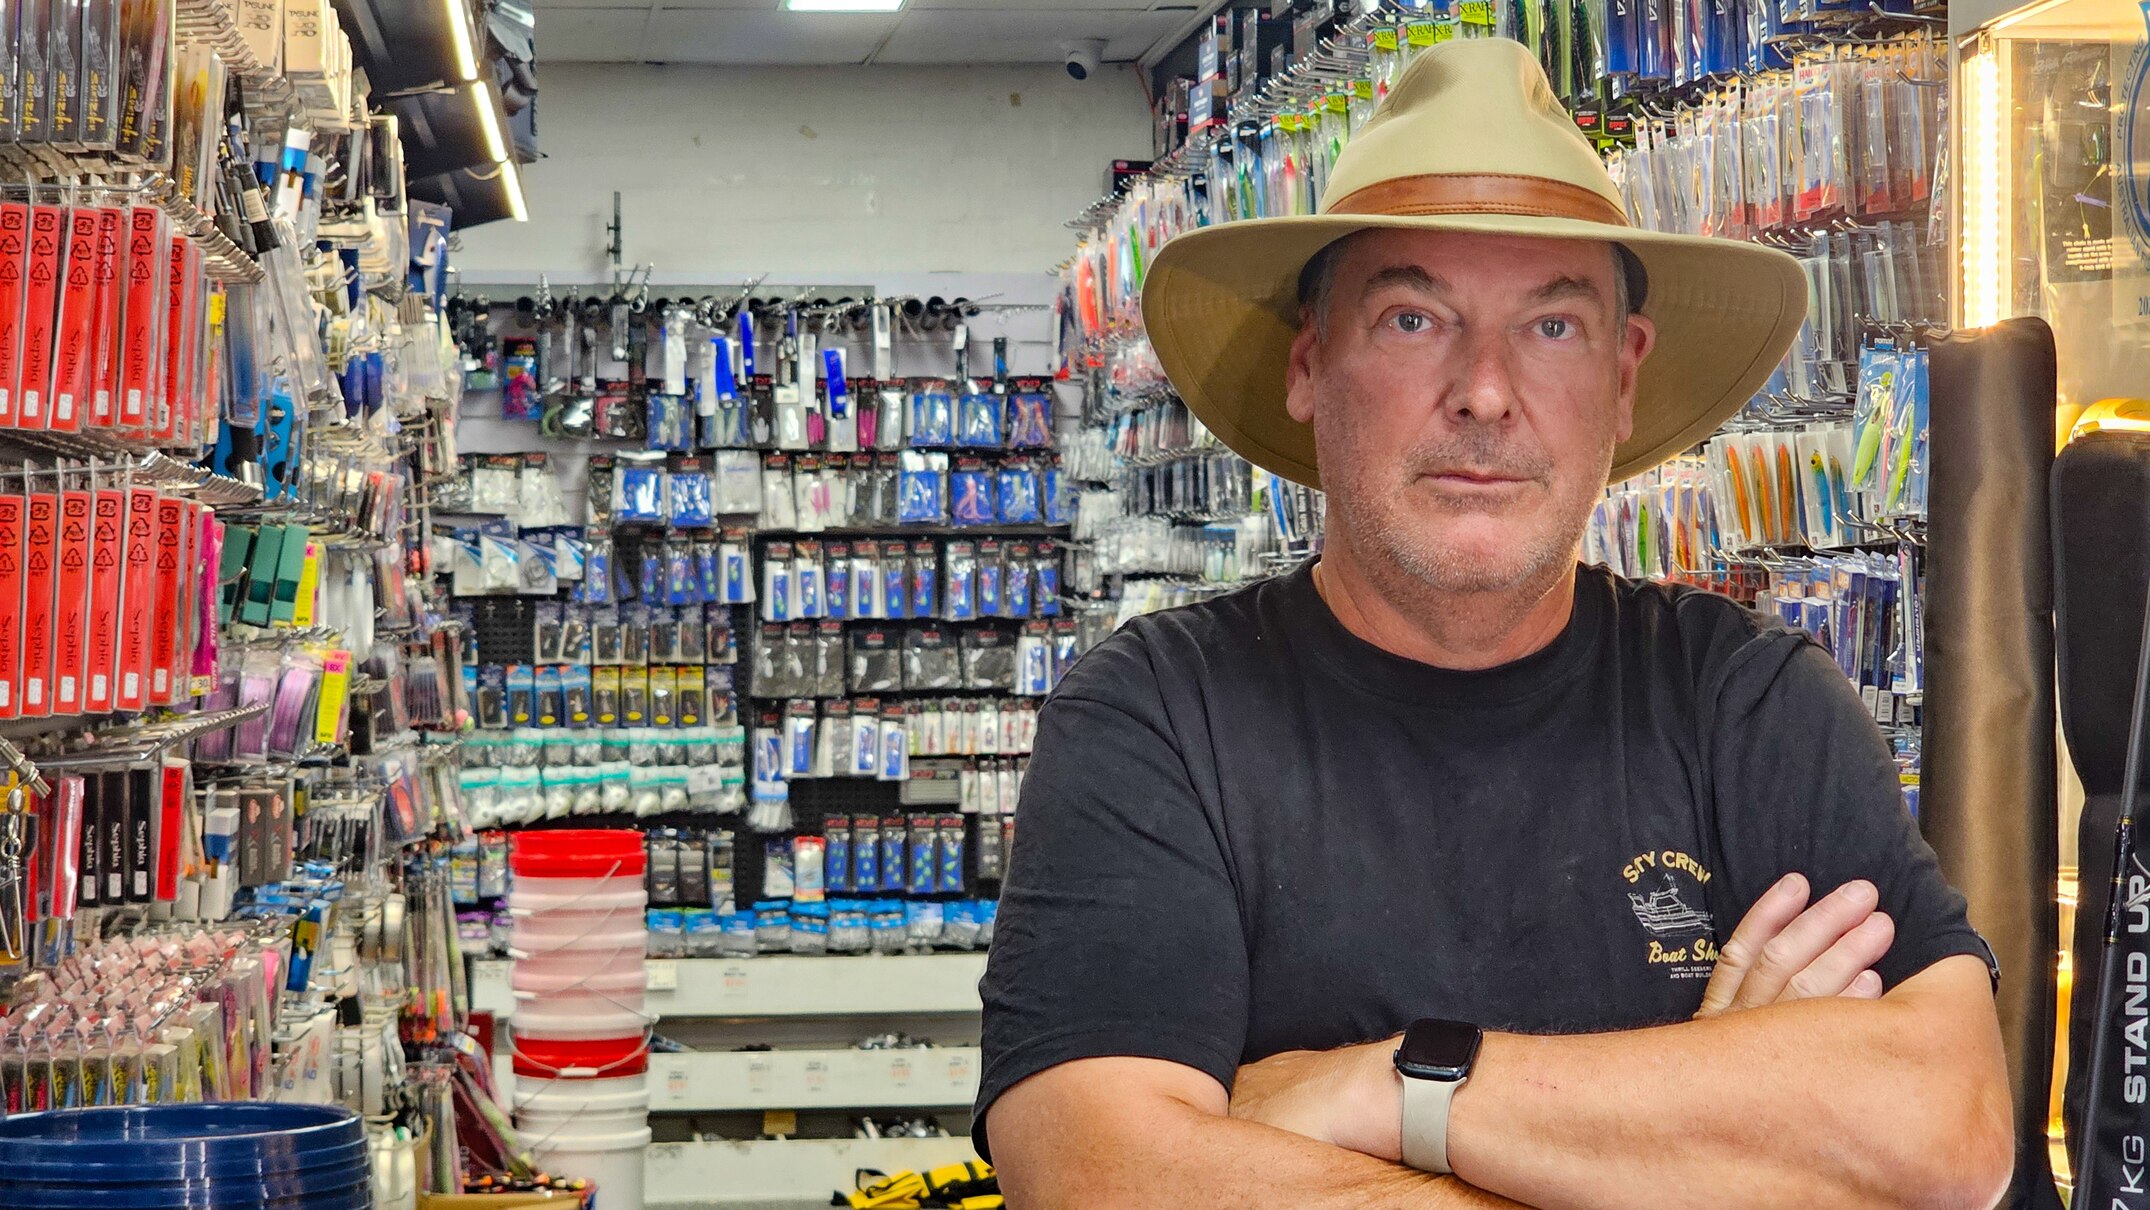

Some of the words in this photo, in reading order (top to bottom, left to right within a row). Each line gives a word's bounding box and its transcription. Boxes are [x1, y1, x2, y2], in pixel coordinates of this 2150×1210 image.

[30, 326, 43, 383] Sephia
[65, 329, 80, 386] Sephia
[132, 326, 145, 381] Sephia
[31, 613, 45, 670] Sephia
[64, 612, 77, 669] Sephia
[97, 611, 110, 667] Sephia
[129, 608, 143, 664] Sephia
[158, 609, 171, 662] Sephia
[86, 824, 96, 870] Sephia
[111, 821, 122, 868] Sephia
[137, 820, 148, 865] Sephia
[1662, 850, 1711, 884] CREW
[2127, 875, 2149, 933] UP
[1648, 940, 1687, 964] Boat
[2123, 951, 2148, 1104] STAND
